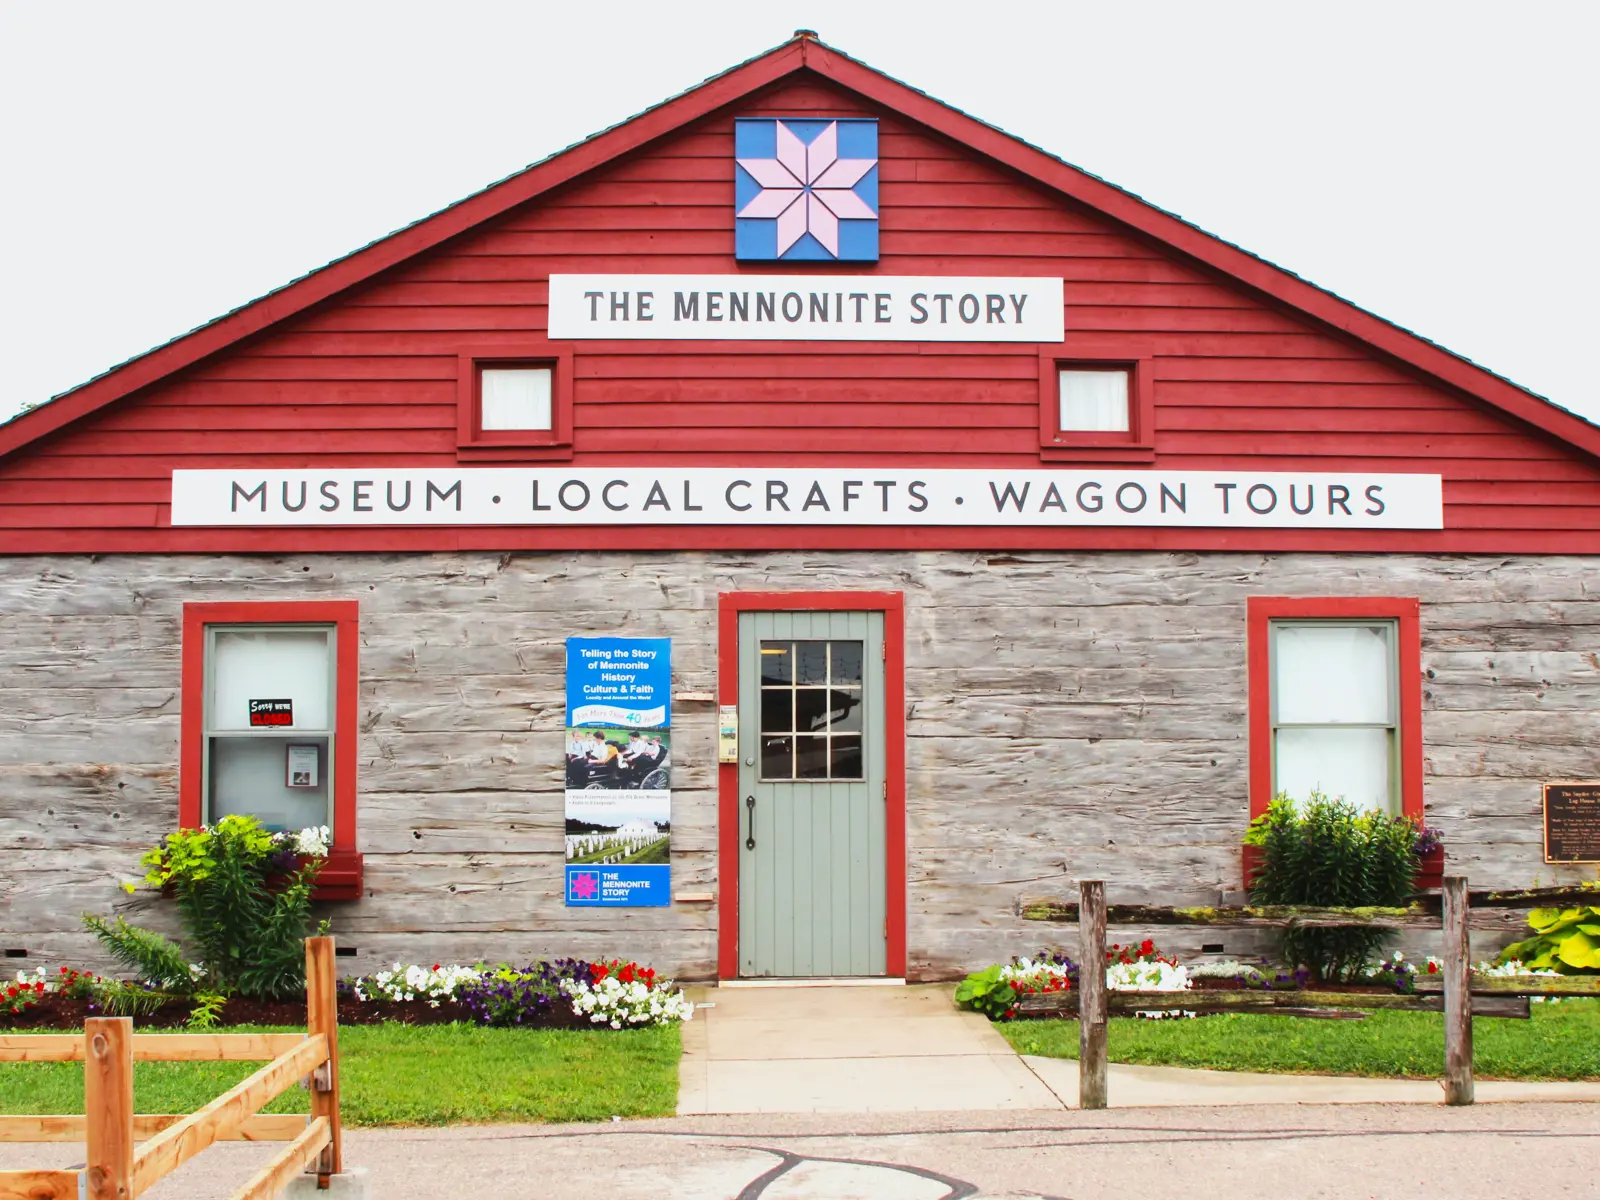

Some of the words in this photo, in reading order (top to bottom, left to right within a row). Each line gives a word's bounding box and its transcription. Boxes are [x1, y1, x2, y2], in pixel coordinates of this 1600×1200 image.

[585, 292, 653, 321] THE
[675, 292, 891, 322] MENNONITE
[911, 294, 1027, 323] STORY
[232, 480, 462, 512] MUSEUM
[533, 480, 702, 512] LOCAL
[726, 480, 928, 512] CRAFTS
[989, 482, 1185, 514] WAGON
[1215, 483, 1384, 516] TOURS
[580, 649, 611, 659] Telling
[614, 649, 629, 658] the
[631, 649, 657, 659] Story
[588, 661, 597, 669] of
[600, 661, 649, 669] Mennonite
[601, 673, 636, 683] History
[583, 685, 617, 693] Culture
[620, 685, 628, 693] &
[630, 685, 654, 693] Faith
[251, 701, 273, 712] Sorry
[626, 713, 641, 724] 40
[602, 872, 619, 880] THE
